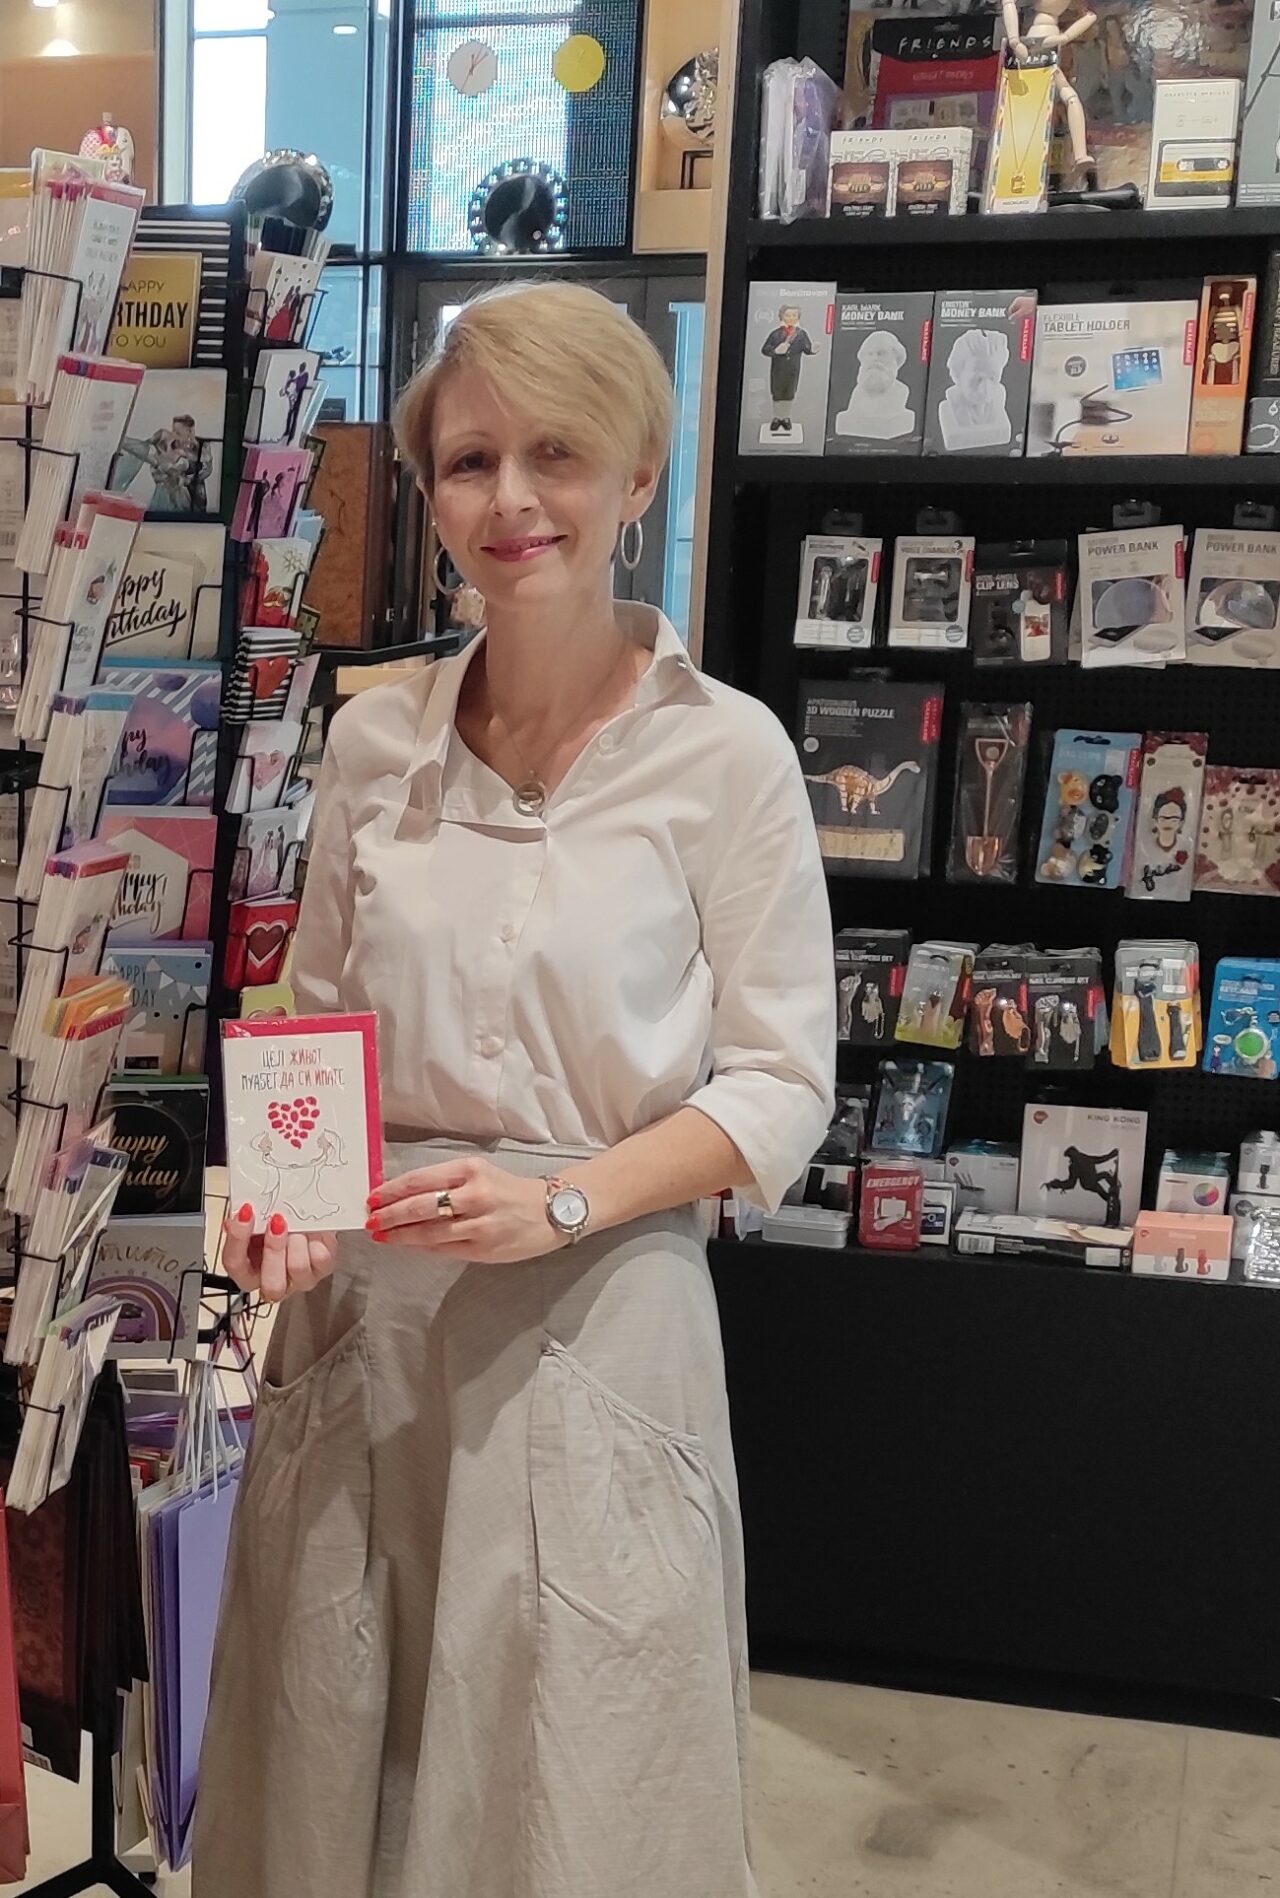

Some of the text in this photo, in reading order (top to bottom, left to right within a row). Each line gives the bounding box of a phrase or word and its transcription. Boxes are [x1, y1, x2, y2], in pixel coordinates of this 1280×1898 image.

[898, 36, 991, 54] FRIENDS
[841, 310, 905, 321] MONEY BANK
[941, 308, 1006, 318] MONEY BANK
[1044, 320, 1131, 332] TABLET HOLDER
[134, 335, 167, 348] YOU
[1088, 541, 1159, 556] POWER BANK
[1206, 542, 1278, 555] POWER BANK
[861, 708, 896, 719] PUZZLE
[262, 1048, 322, 1069] ЦЕЛ ЖИВОТ
[241, 1072, 278, 1091] МУАБЕТ
[279, 1071, 294, 1089] ДА
[298, 1071, 312, 1086] СИ
[1087, 1114, 1141, 1124] KING KONG
